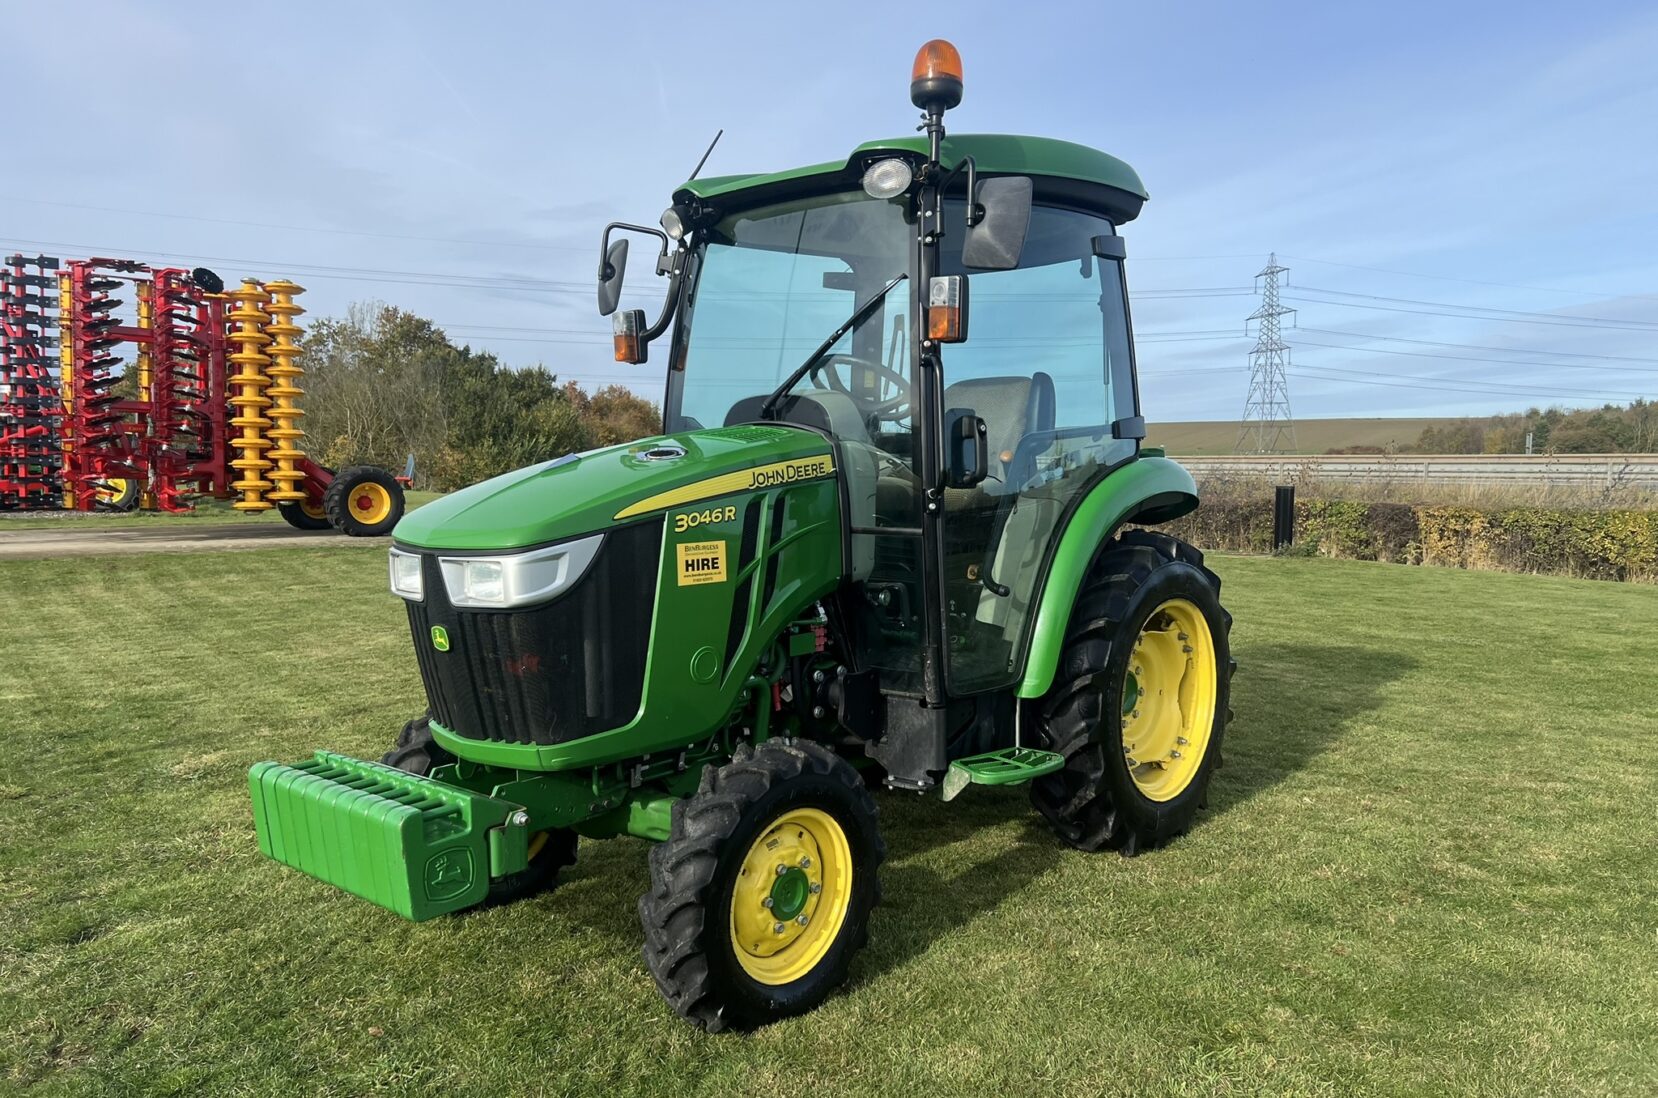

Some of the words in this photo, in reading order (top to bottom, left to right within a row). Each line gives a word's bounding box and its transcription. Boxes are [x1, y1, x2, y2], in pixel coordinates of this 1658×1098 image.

[749, 469, 785, 488] JOHN
[786, 462, 826, 480] DEERE
[674, 506, 737, 533] 3046R
[685, 557, 720, 572] HIRE
